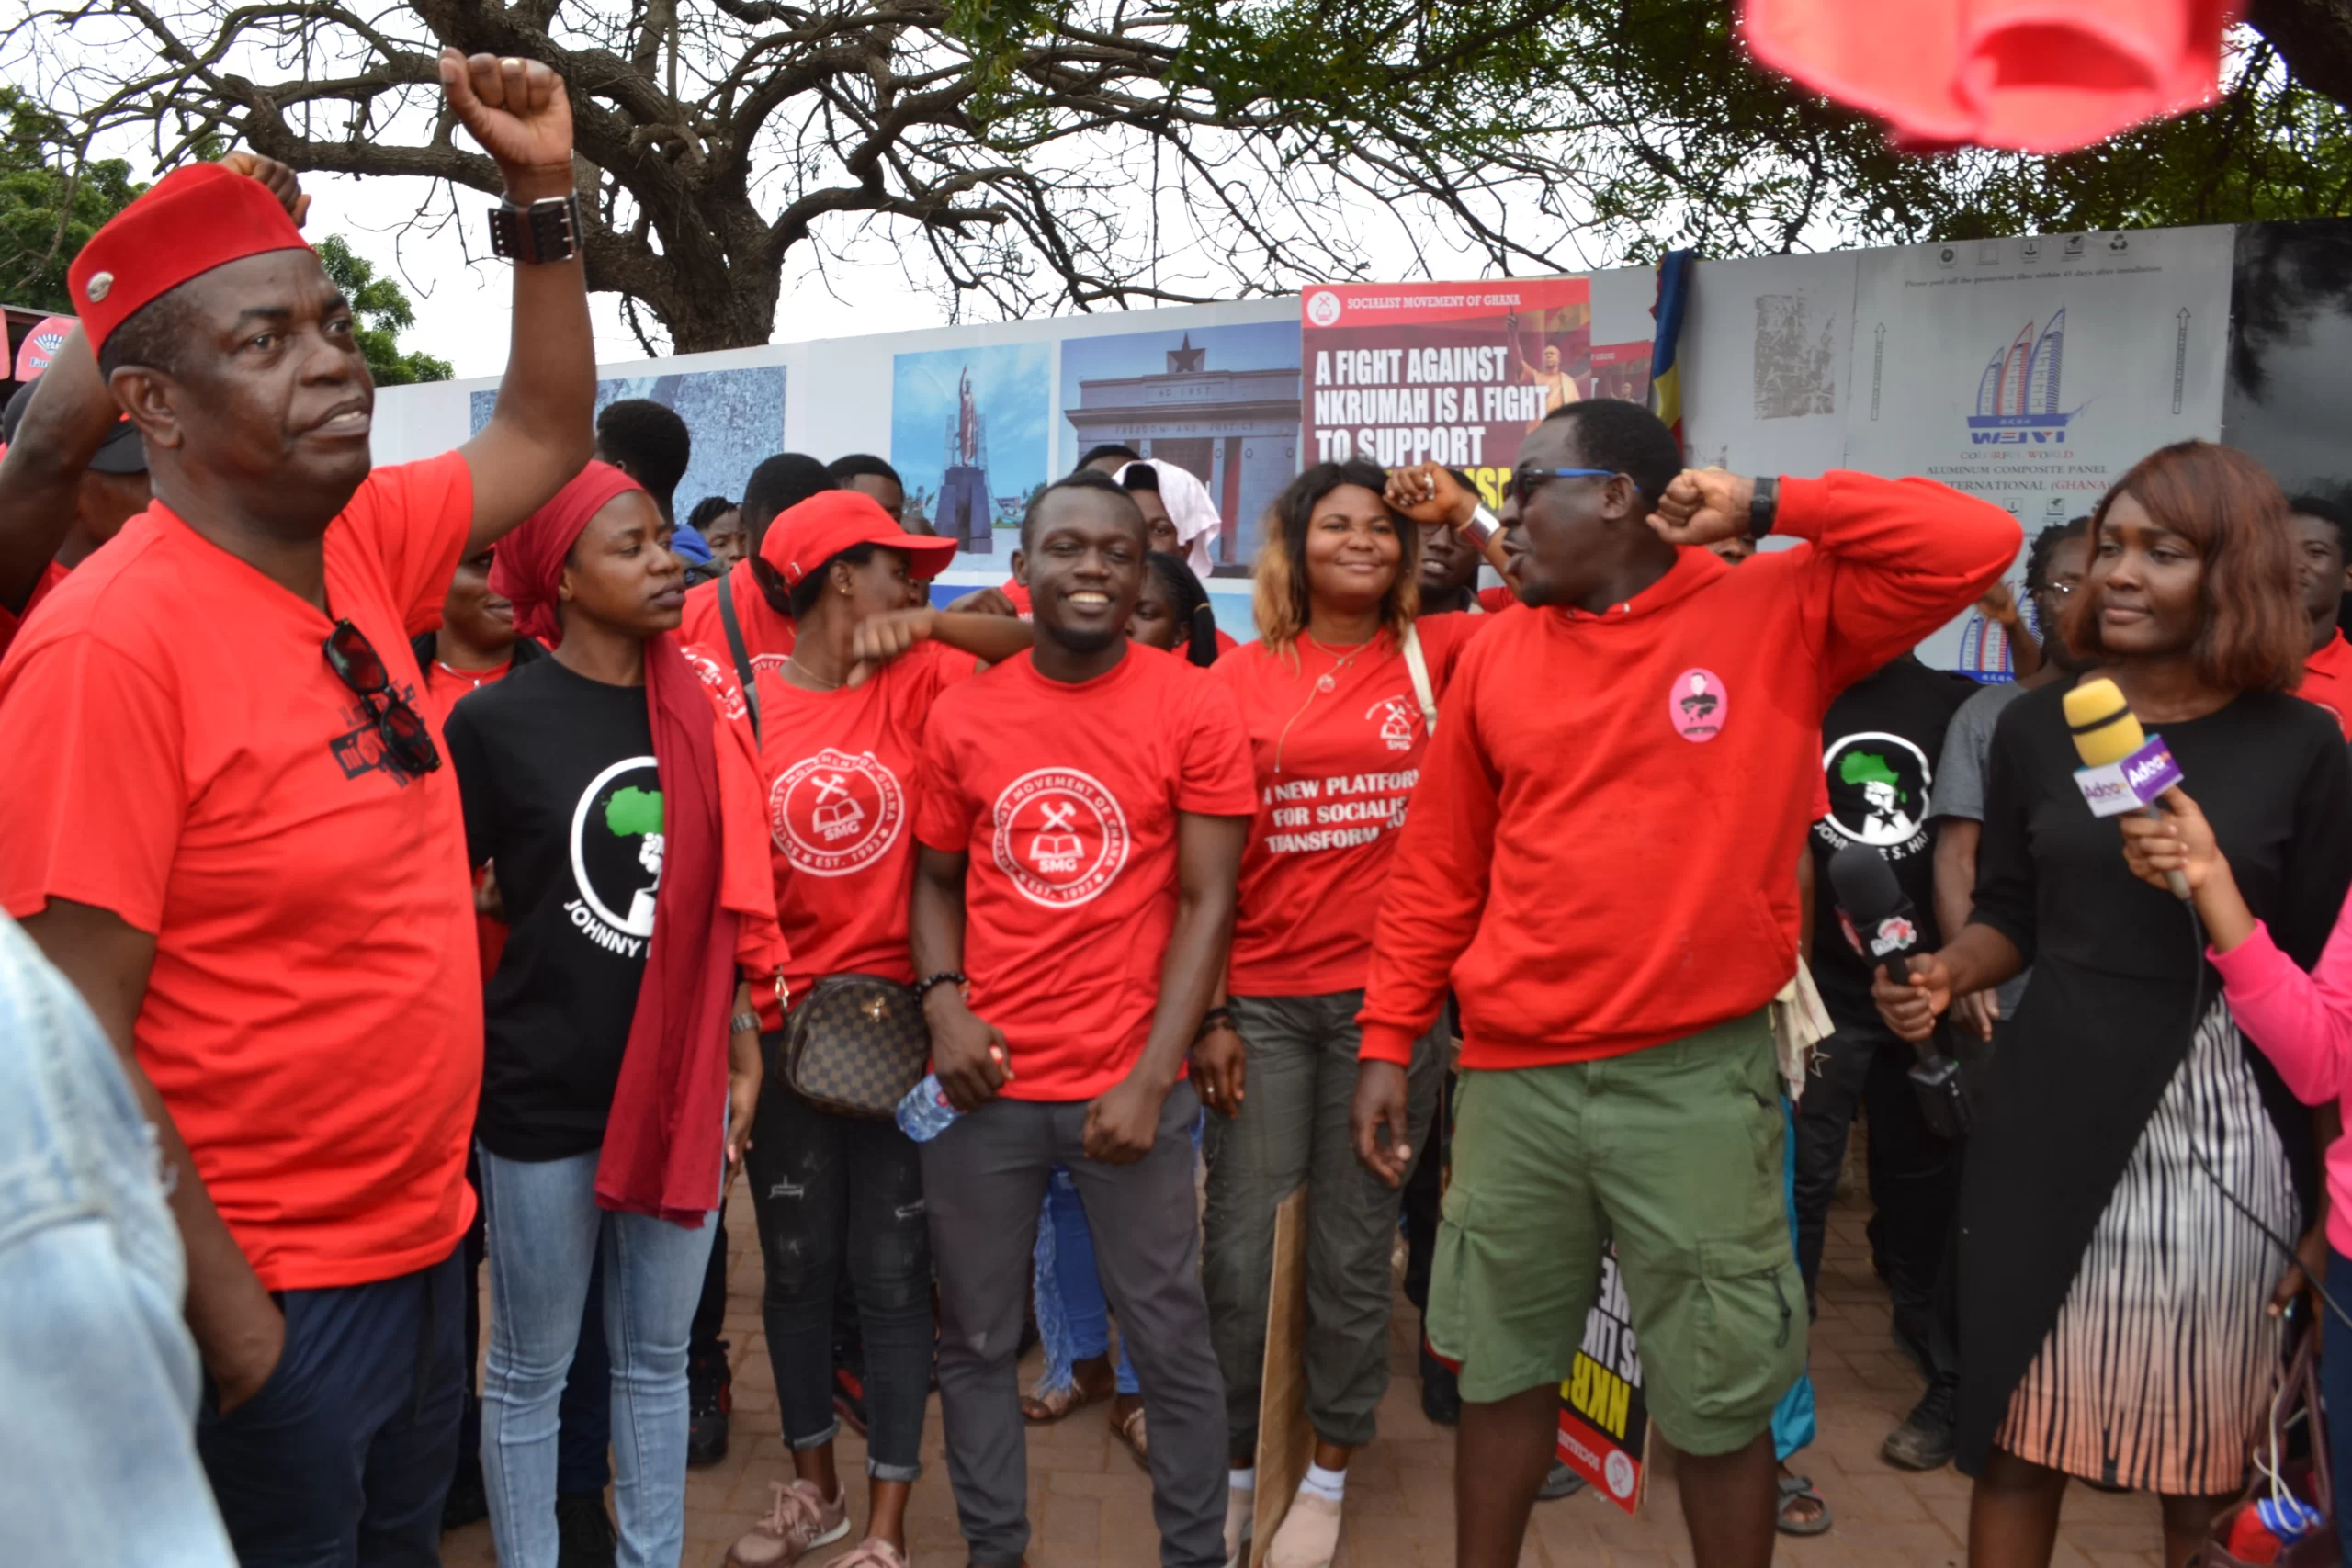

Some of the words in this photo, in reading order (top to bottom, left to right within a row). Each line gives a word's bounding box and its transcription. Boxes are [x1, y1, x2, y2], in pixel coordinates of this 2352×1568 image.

[1347, 297, 1401, 310] SOCIALIST
[1404, 295, 1464, 309] MOVEMENT
[1467, 295, 1483, 306] OF
[1484, 293, 1521, 306] GHANA
[1315, 351, 1331, 386] A
[1336, 349, 1403, 385] FIGHT
[1407, 345, 1508, 384] AGAINST
[1314, 388, 1430, 425] NKRUMAH
[1435, 387, 1458, 423] IS
[1463, 387, 1479, 422] A
[1483, 385, 1550, 421] FIGHT
[1315, 428, 1351, 466] TO
[1357, 426, 1486, 467] SUPPORT
[1926, 465, 1990, 475] ALUMINUM
[1994, 465, 2065, 475] COMPOSITE
[2068, 464, 2109, 475] PANEL
[877, 773, 898, 821] GHANA
[1012, 775, 1094, 802] MOVEMENT
[1094, 795, 1113, 816] OF
[1274, 780, 1320, 802] NEW
[1272, 807, 1310, 828] FOR
[823, 820, 861, 841] SMG
[815, 856, 847, 868] EST.
[1038, 858, 1077, 873] SMG
[563, 898, 642, 958] JOHNNY
